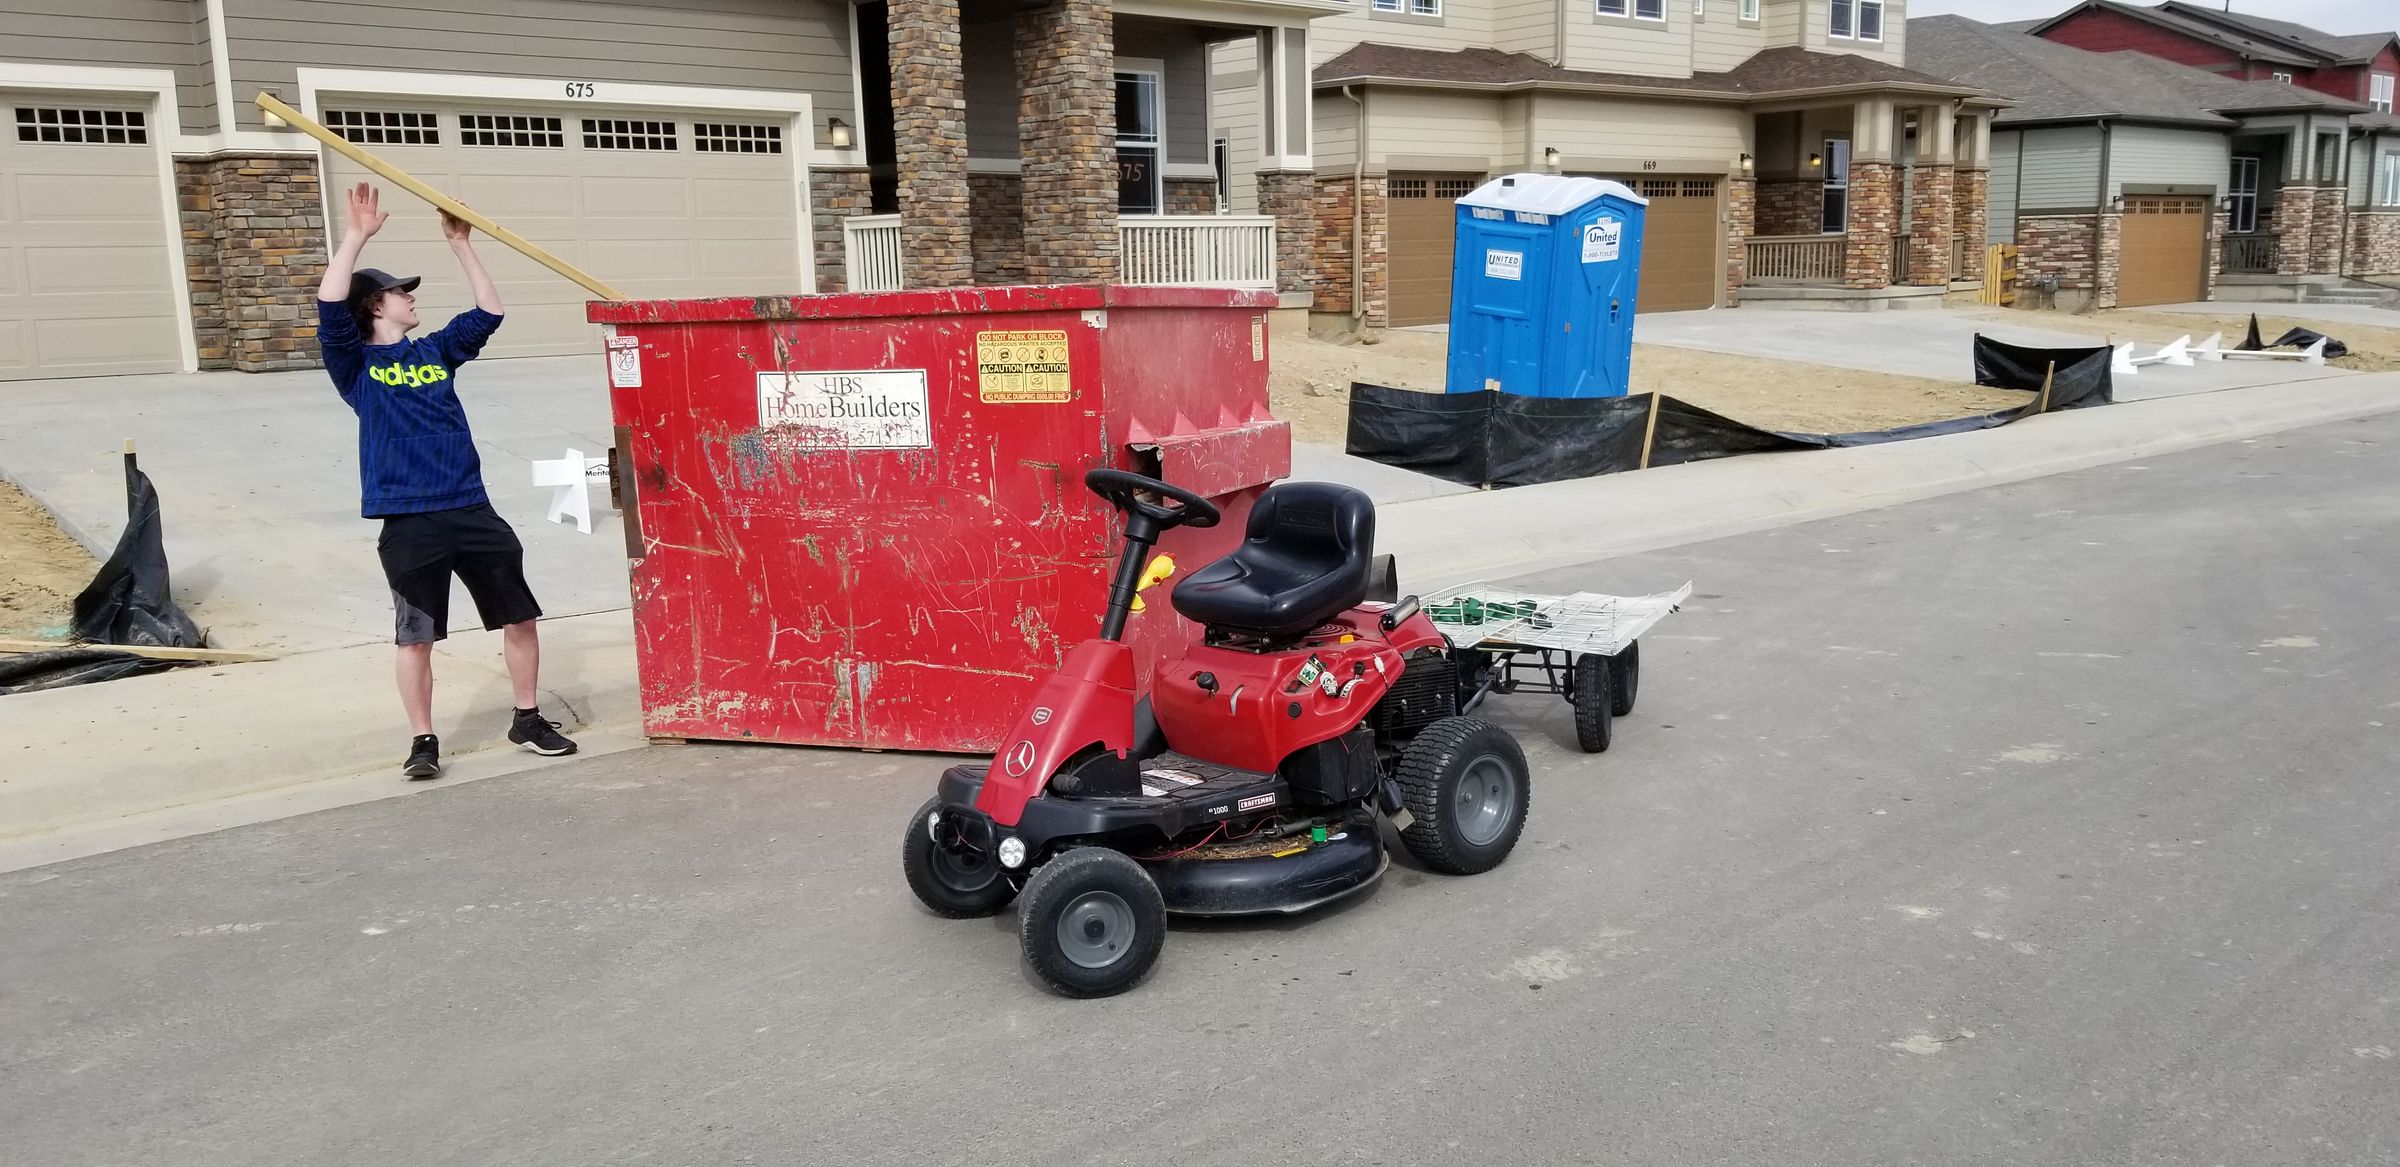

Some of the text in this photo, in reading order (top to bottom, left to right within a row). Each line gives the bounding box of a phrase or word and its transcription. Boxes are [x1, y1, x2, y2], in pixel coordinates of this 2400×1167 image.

[566, 82, 594, 98] 675
[1643, 160, 1657, 170] 669
[1589, 230, 1618, 243] United
[1489, 254, 1519, 265] UNITED
[988, 364, 1022, 373] CAUTION
[1033, 363, 1067, 372] CAUTION
[369, 362, 448, 388] adidas
[824, 376, 863, 394] HBS
[767, 395, 921, 418] HomeBuilders
[1240, 795, 1273, 809] CRAFTSMAN
